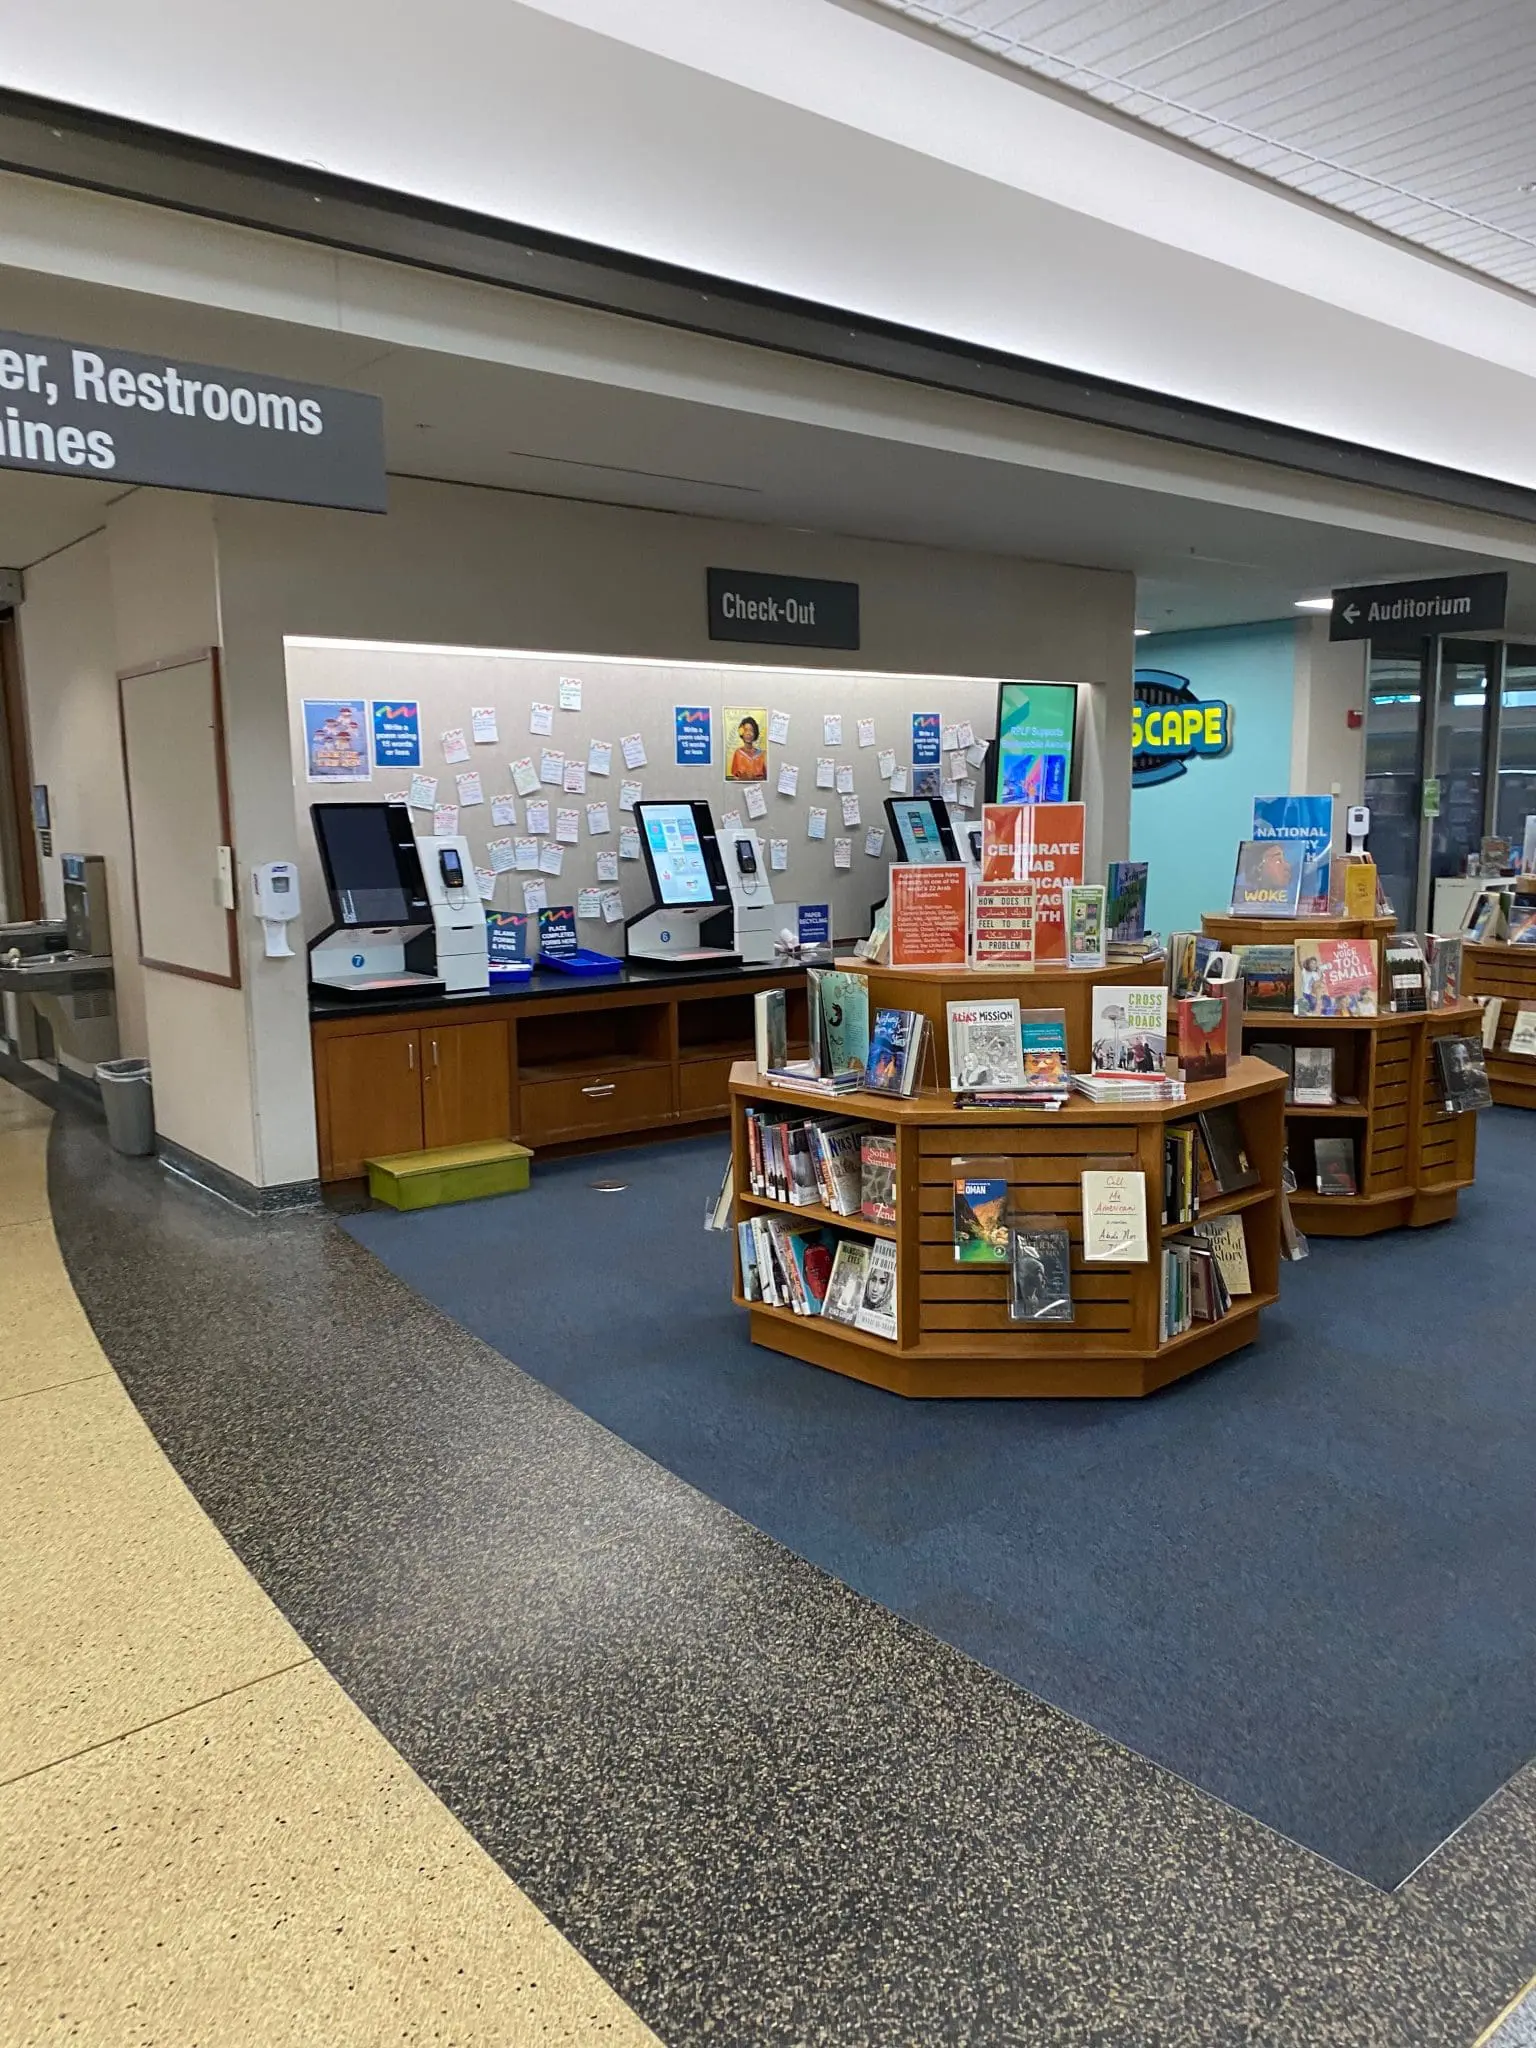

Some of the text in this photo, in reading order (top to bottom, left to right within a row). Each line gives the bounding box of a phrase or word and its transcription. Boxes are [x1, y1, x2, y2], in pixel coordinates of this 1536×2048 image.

[72, 349, 324, 436] Restrooms
[722, 592, 816, 624] Check-Out
[1368, 597, 1471, 622] Auditorium
[397, 733, 417, 741] using
[1257, 827, 1327, 838] NATIONAL
[988, 843, 1080, 856] CELBRATE
[1244, 889, 1288, 902] WOKE
[978, 920, 1031, 928] FEEL TO BE
[541, 931, 575, 939] COMPLETED
[989, 941, 1020, 949] PROBLEM
[1337, 941, 1349, 950] NO
[1333, 947, 1357, 959] VOICE
[1333, 955, 1361, 970] TOO
[1329, 964, 1373, 983] SMALL
[1128, 993, 1162, 1006] CROSS
[1128, 1015, 1162, 1028] ROADS
[1106, 1176, 1124, 1186] Call
[965, 1185, 986, 1195] OMAN
[1232, 1237, 1243, 1250] of
